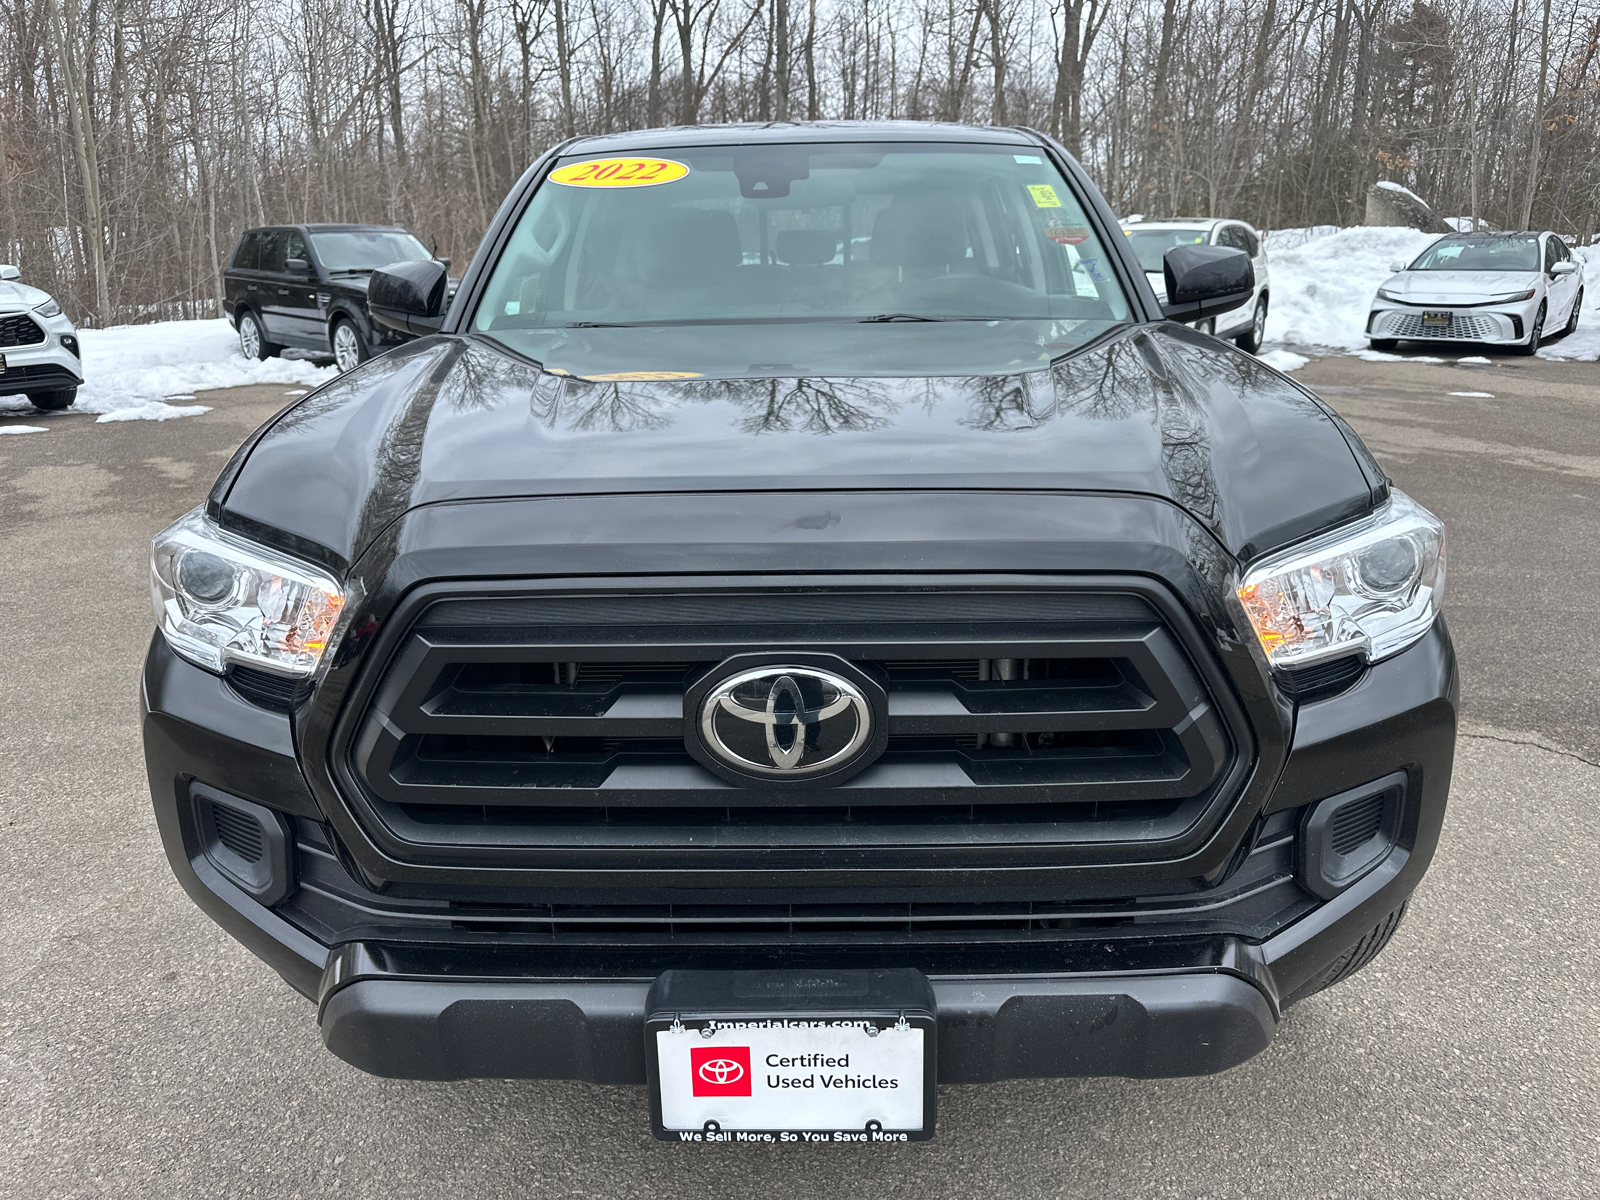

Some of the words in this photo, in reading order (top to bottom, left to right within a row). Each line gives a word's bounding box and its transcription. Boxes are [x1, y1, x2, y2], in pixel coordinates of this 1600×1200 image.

[568, 163, 668, 181] 2022
[709, 1019, 871, 1030] Imperialcars.com
[765, 1053, 849, 1067] Certified
[766, 1074, 815, 1088] Used
[819, 1074, 899, 1089] Vehicles
[679, 1131, 702, 1141] We
[706, 1131, 732, 1142] Sell
[736, 1131, 776, 1143] More,
[780, 1131, 798, 1142] So
[802, 1131, 830, 1142] You
[833, 1131, 868, 1142] Save
[872, 1131, 908, 1142] More
